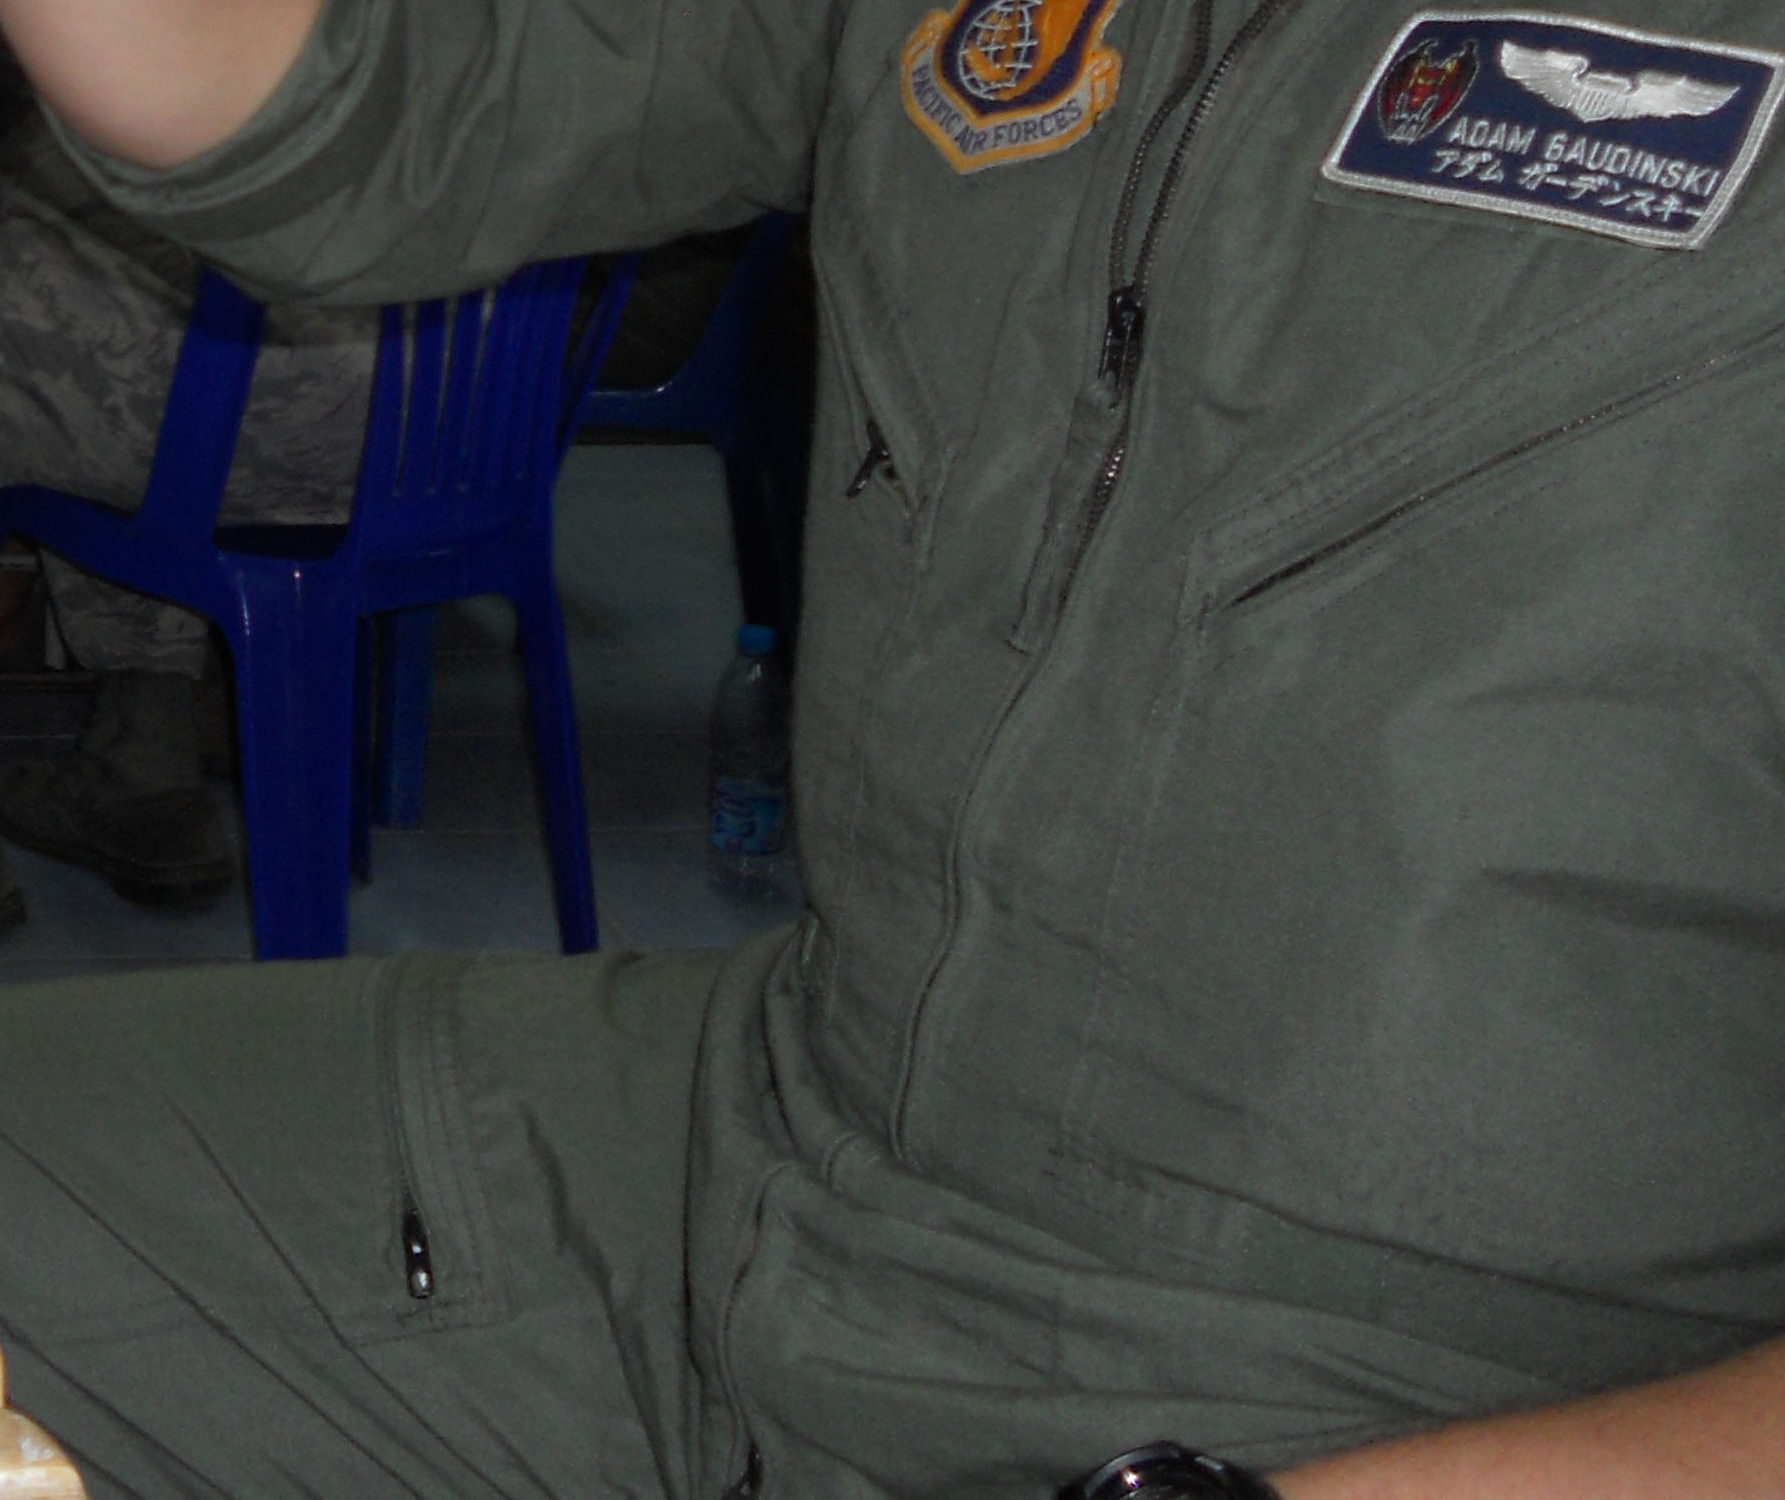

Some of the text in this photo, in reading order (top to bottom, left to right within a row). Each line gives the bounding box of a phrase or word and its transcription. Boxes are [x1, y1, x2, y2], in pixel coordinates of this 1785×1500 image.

[912, 64, 1083, 154] PACIFIC AIR FORCES
[1430, 148, 1505, 183] アダム
[1449, 116, 1719, 197] ADAM GAUDINSKI
